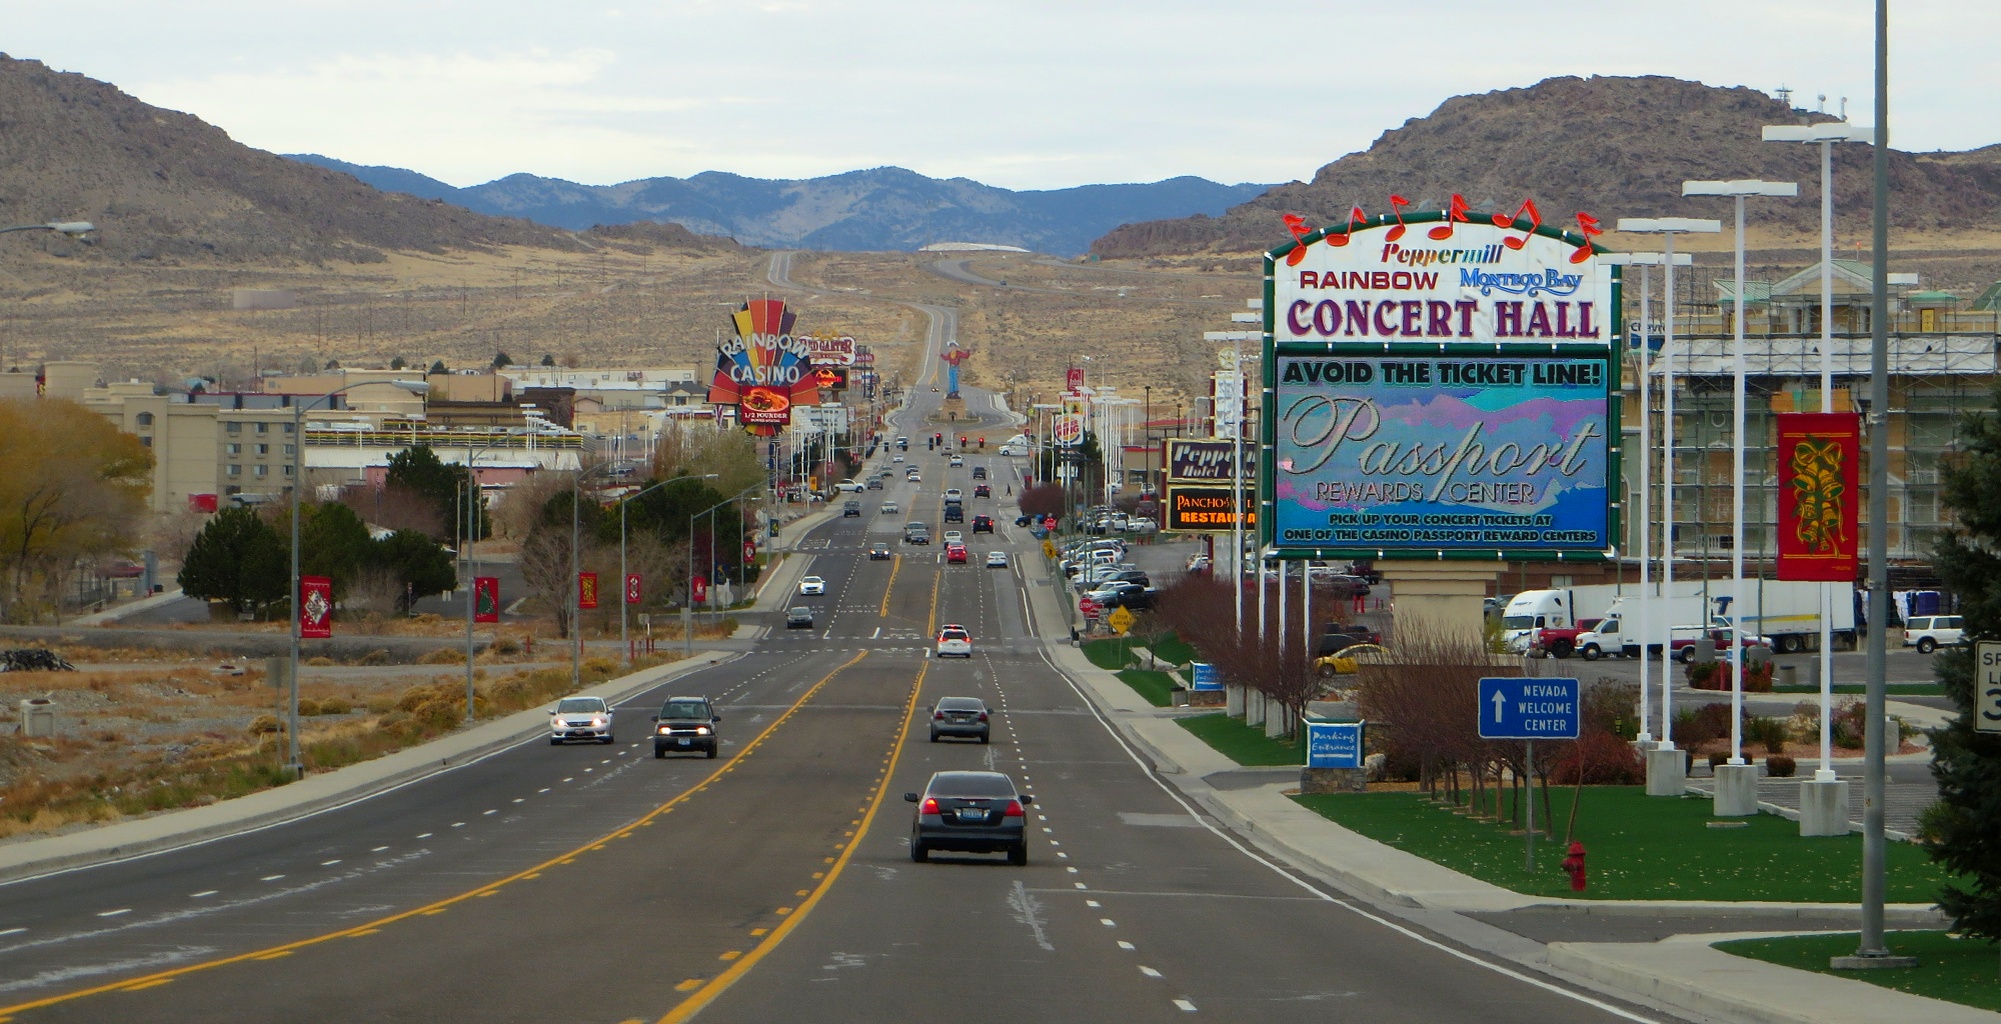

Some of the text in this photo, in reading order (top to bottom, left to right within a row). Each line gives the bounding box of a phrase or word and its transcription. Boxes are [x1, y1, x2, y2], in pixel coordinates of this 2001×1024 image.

[1381, 243, 1504, 266] Peppermill
[1300, 271, 1438, 289] RAINBOW
[1287, 299, 1600, 339] CONCERT HALL
[721, 332, 811, 359] RAINBOW
[730, 365, 800, 383] CASINO
[1283, 362, 1600, 384] AVOID THE TICKET LINE!
[1283, 395, 1601, 503] Passport
[1182, 465, 1219, 477] Hotel
[1315, 482, 1535, 502] REWARDS CENTER
[1177, 495, 1223, 510] PANCHO
[1329, 514, 1552, 525] PICK UP YOUR CONCERT TICKETS AT
[1284, 529, 1597, 541] ONE OF THE CASINO PASSPORT REWARD CENTERS
[1523, 685, 1567, 697] NEVADA
[1518, 702, 1572, 714] WELCOME
[1524, 719, 1567, 731] CENTER
[1312, 731, 1356, 743] Parking
[1311, 742, 1355, 751] Entrance
